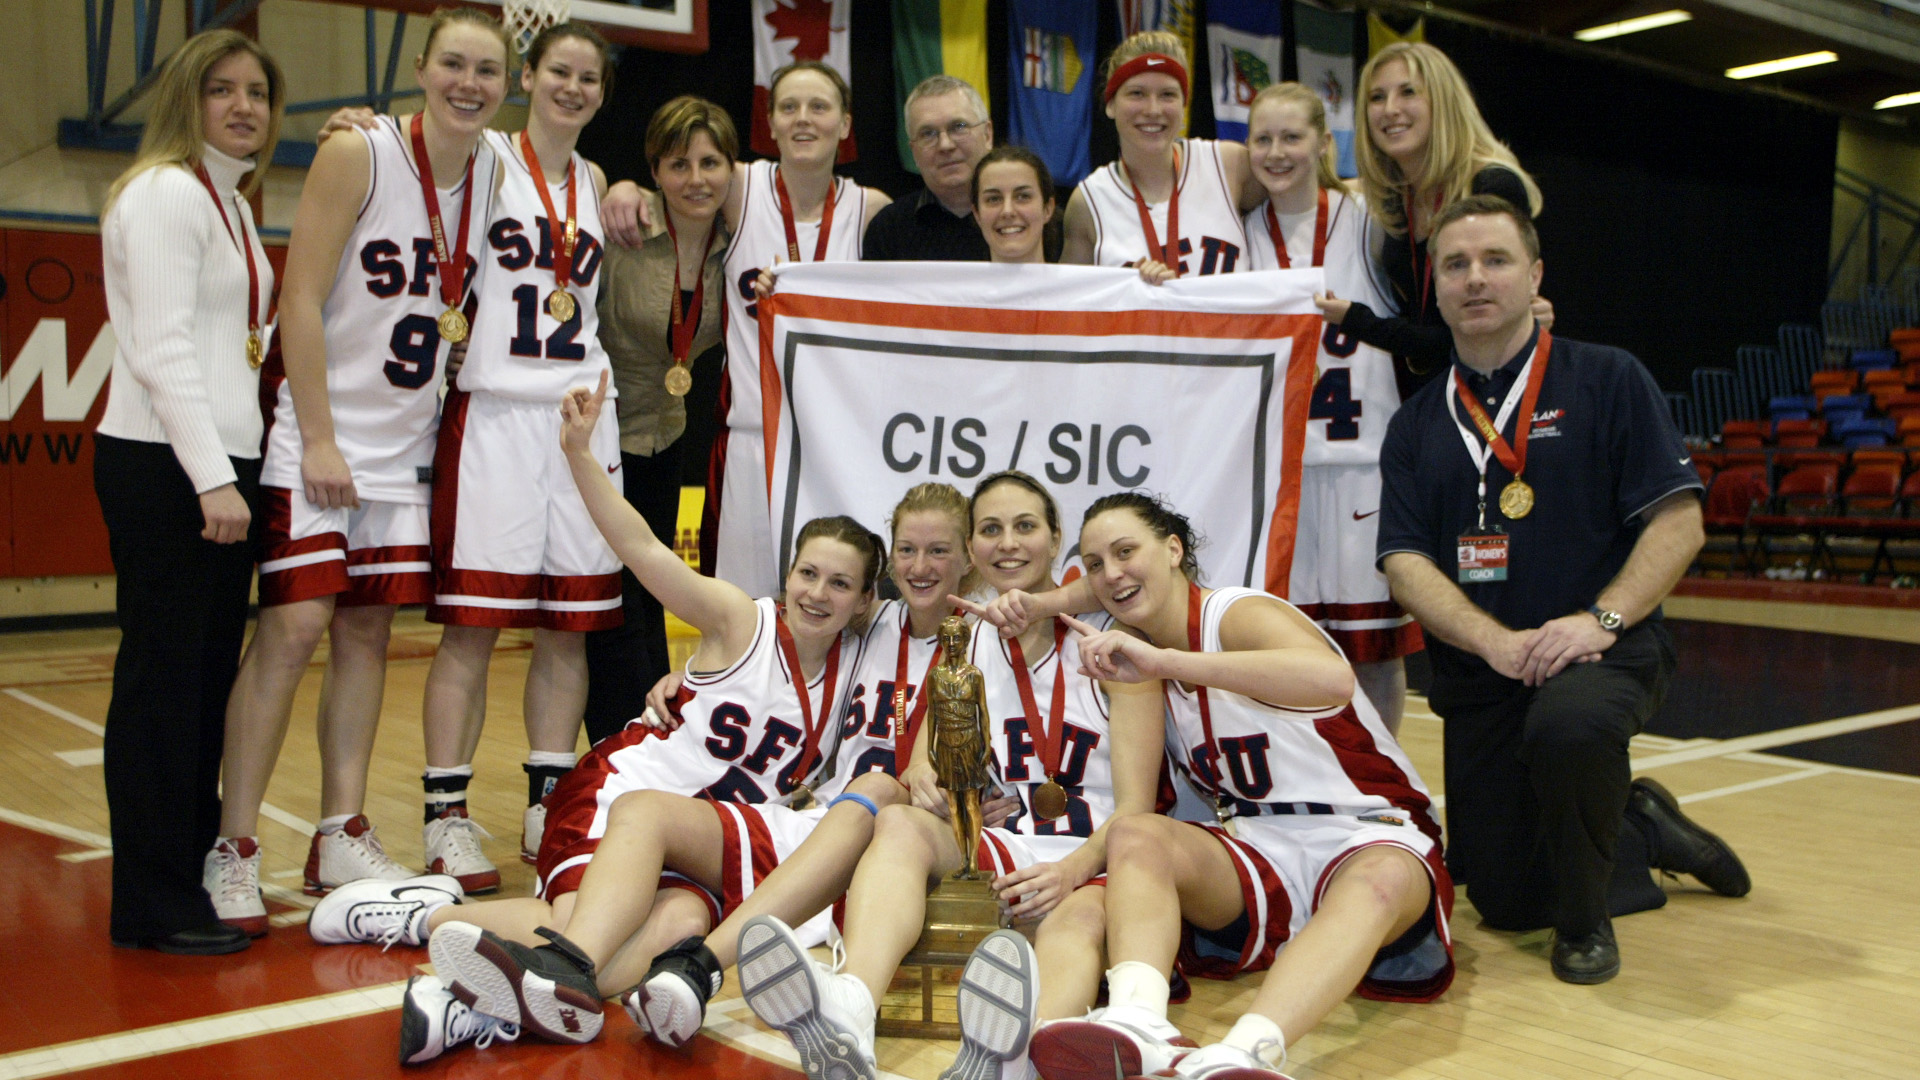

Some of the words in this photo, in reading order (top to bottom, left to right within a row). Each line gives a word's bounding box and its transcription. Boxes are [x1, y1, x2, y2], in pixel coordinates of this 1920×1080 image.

[430, 214, 448, 263] BASKETBALL
[383, 313, 441, 390] 9
[510, 284, 586, 361] 12
[882, 412, 987, 478] CIS
[1044, 422, 1152, 488] SIC
[1469, 569, 1495, 580] COACH
[842, 680, 918, 741] SF
[896, 689, 905, 736] BASKETBALL
[990, 715, 1101, 787] FU
[558, 1007, 583, 1033] NIKE
